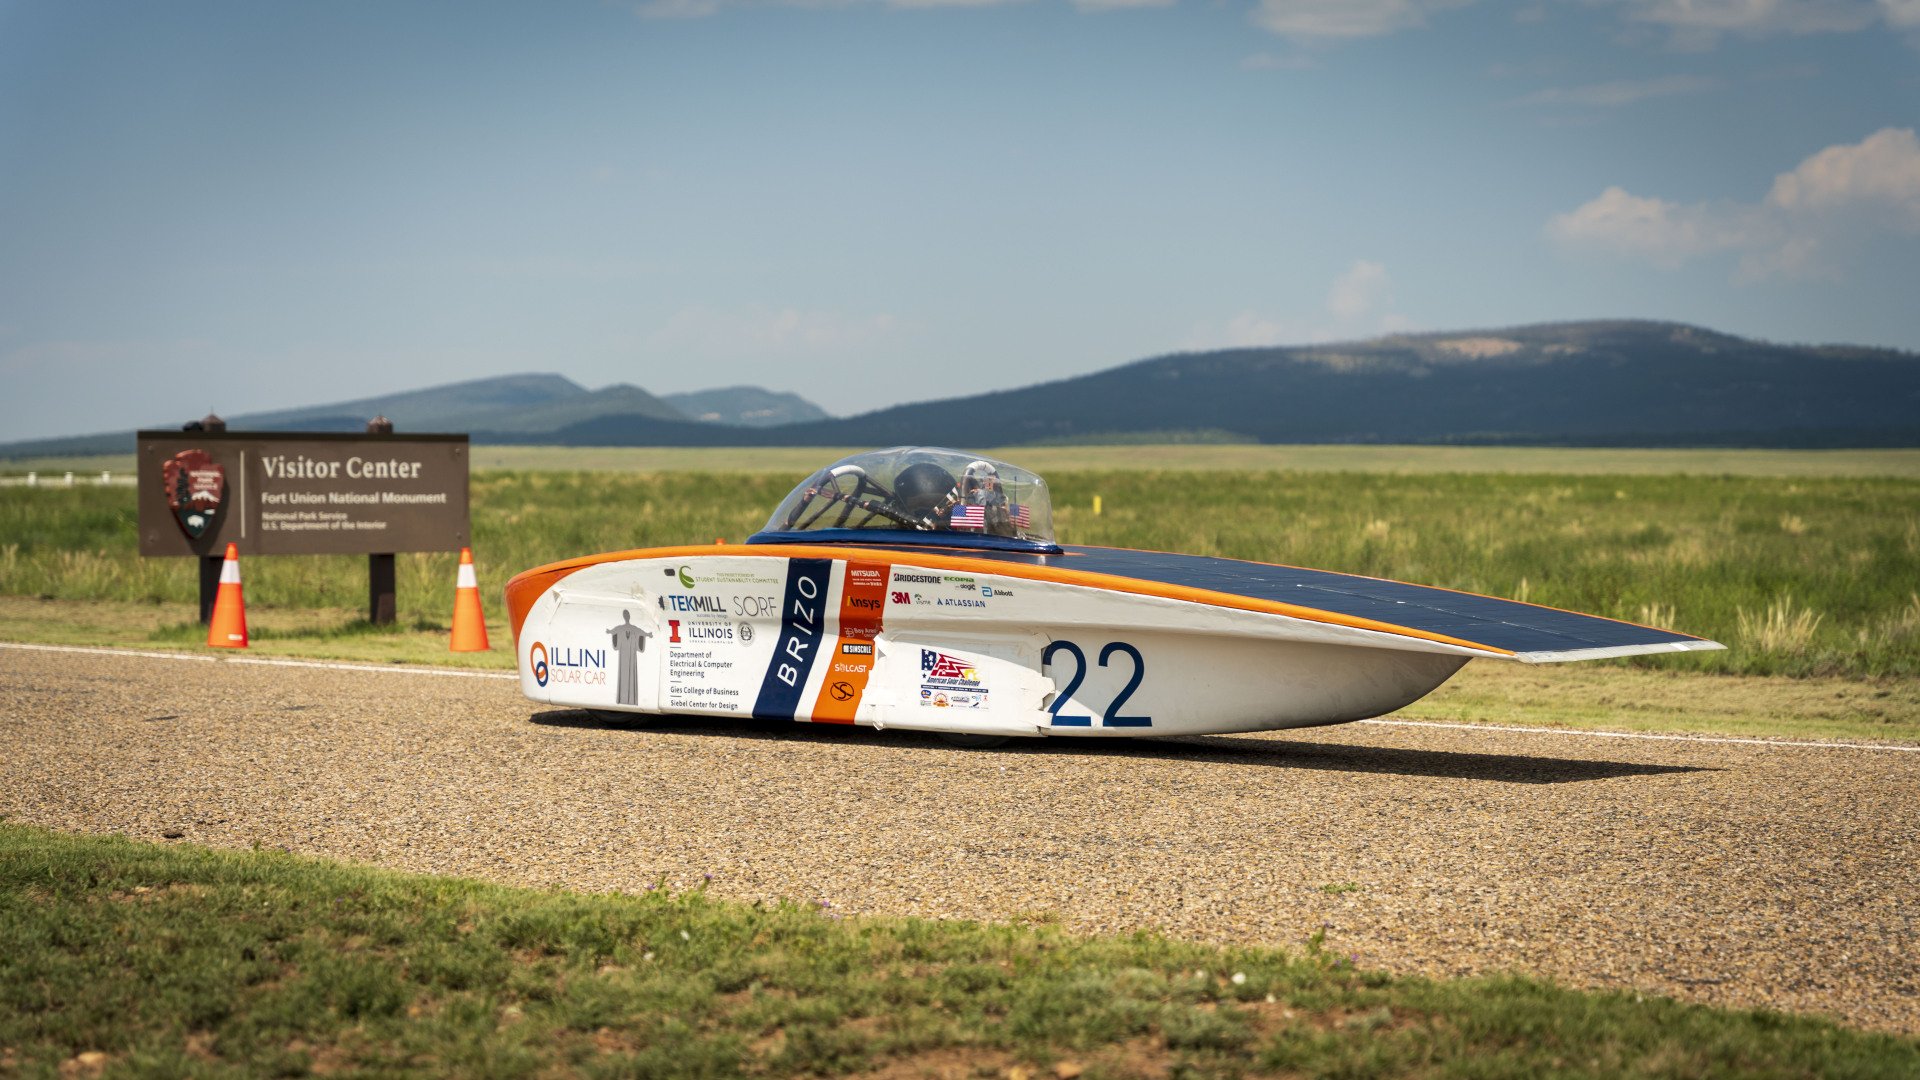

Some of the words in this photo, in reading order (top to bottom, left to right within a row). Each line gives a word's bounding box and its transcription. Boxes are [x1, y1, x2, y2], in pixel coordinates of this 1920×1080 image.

[262, 455, 340, 478] Visitor
[346, 456, 422, 478] Center
[262, 492, 286, 504] Fort
[289, 492, 326, 504] Union
[328, 491, 379, 504] National
[382, 492, 446, 504] Monument
[262, 511, 297, 520] National
[298, 511, 317, 520] Park
[318, 511, 348, 520] Service
[262, 521, 279, 530] U.S.
[280, 521, 330, 532] Department
[330, 521, 341, 530] of
[341, 521, 355, 530] the
[356, 521, 387, 530] Interior
[894, 573, 941, 584] BRIDGESTONE
[892, 591, 911, 605] 3M
[994, 589, 1014, 597] Abbott
[669, 595, 727, 612] TEKMILL
[733, 595, 777, 617] SORF
[945, 598, 986, 608] ATLASSIAN
[689, 627, 733, 639] ILLINOIS
[777, 576, 817, 687] BRIZO
[551, 647, 606, 668] ILLINI
[670, 651, 705, 659] Department
[705, 651, 712, 659] of
[670, 660, 697, 668] Electrical
[703, 661, 733, 669] Computer
[551, 668, 581, 683] SOLAR
[584, 670, 606, 685] CAR
[670, 669, 705, 678] Engineering
[1042, 640, 1152, 727] 22
[670, 686, 683, 694] Gies
[683, 687, 705, 696] College
[705, 687, 712, 695] of
[713, 688, 739, 696] Business
[718, 702, 739, 710] Design
